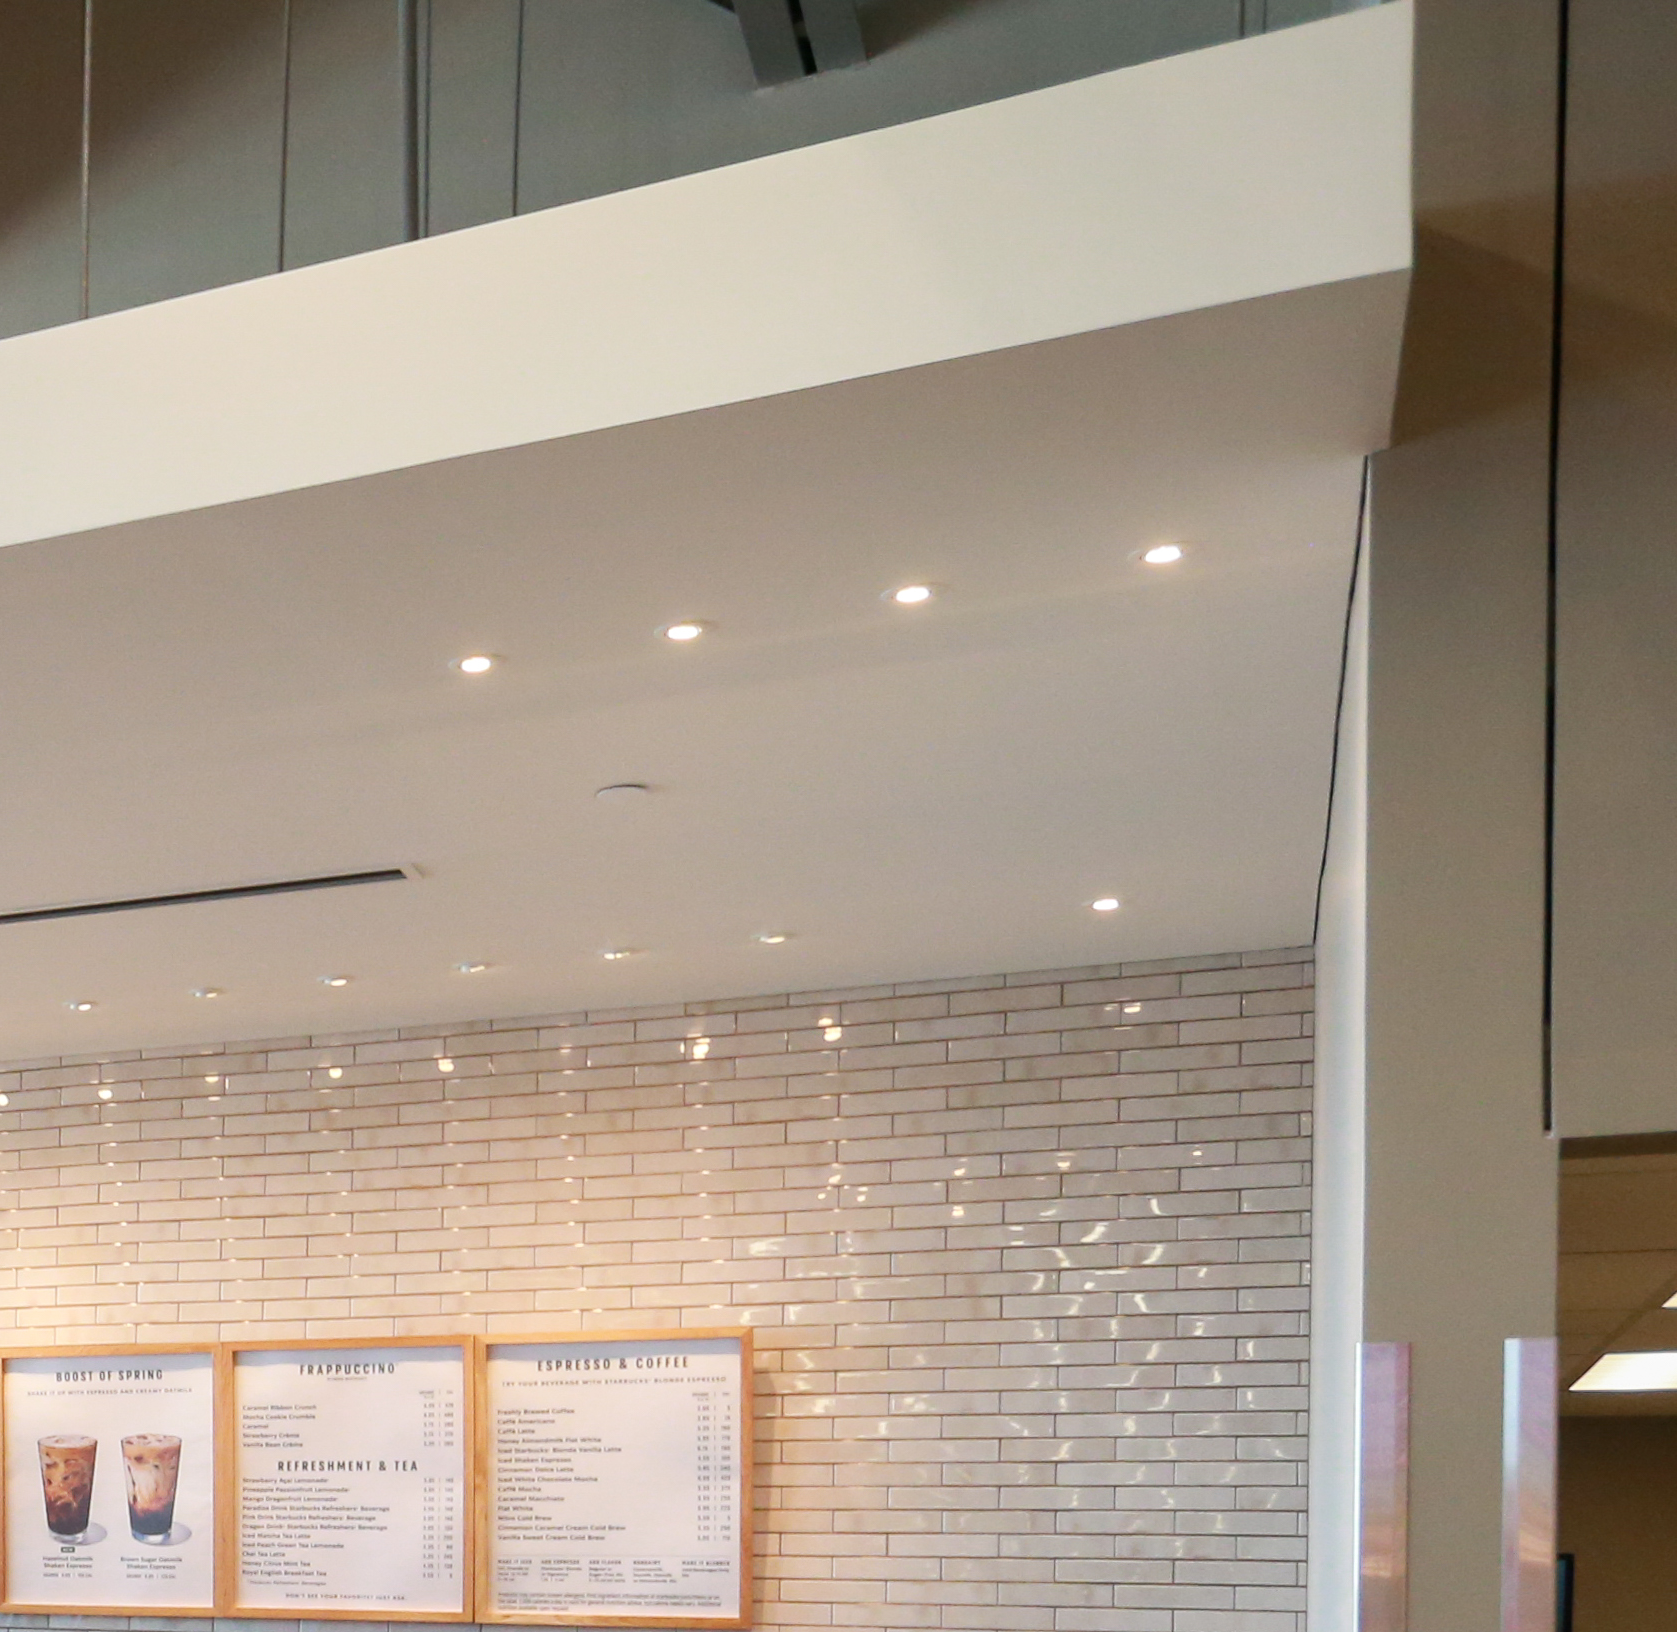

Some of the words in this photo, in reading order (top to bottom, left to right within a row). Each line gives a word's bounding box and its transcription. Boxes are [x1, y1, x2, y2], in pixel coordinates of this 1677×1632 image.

[300, 1363, 396, 1376] FRAPPUCCINO
[537, 1358, 611, 1371] ESPRESSO
[618, 1359, 628, 1370] &
[636, 1356, 688, 1369] COFFEE
[56, 1371, 93, 1382] BOOST
[99, 1371, 112, 1381] OF
[118, 1369, 163, 1381] SPRING
[278, 1461, 372, 1472] REFRESHMENT
[379, 1461, 387, 1471] &
[394, 1461, 418, 1472] TEA
